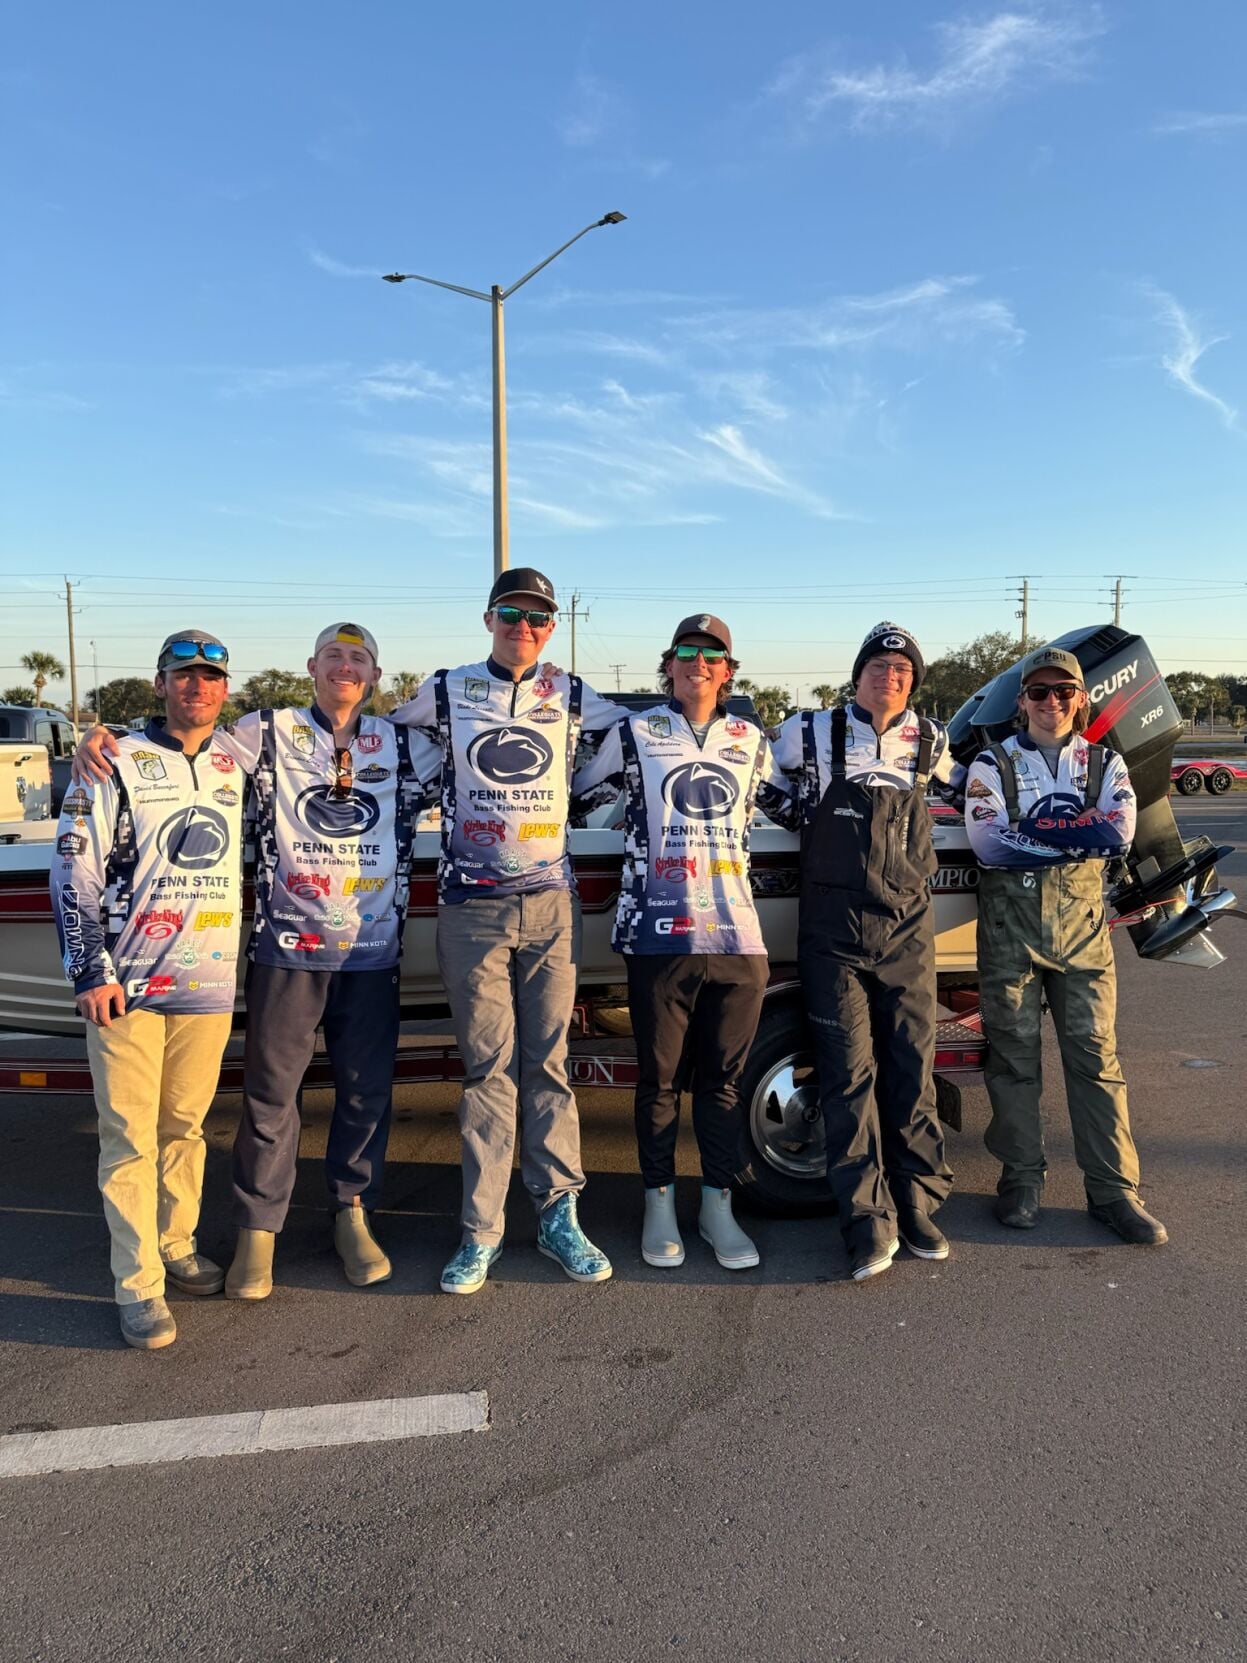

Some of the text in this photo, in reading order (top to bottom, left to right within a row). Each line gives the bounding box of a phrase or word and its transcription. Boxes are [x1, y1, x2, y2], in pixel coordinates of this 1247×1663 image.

[1087, 660, 1138, 704] CURY
[1140, 705, 1164, 729] XR6
[469, 790, 554, 801] PENN STATE
[474, 804, 552, 813] Bass Fishing Club
[661, 825, 739, 839] PENN STATE
[293, 842, 380, 855] PENN STATE
[665, 840, 737, 850] Bass Fishing Club
[296, 856, 377, 868] Bass Fishing Club
[150, 876, 230, 889] PENN STATE
[150, 891, 226, 901] Bass Fishing Club
[647, 898, 679, 907] Seaguar
[273, 909, 307, 922] Seaguar
[119, 957, 157, 967] Seaguar
